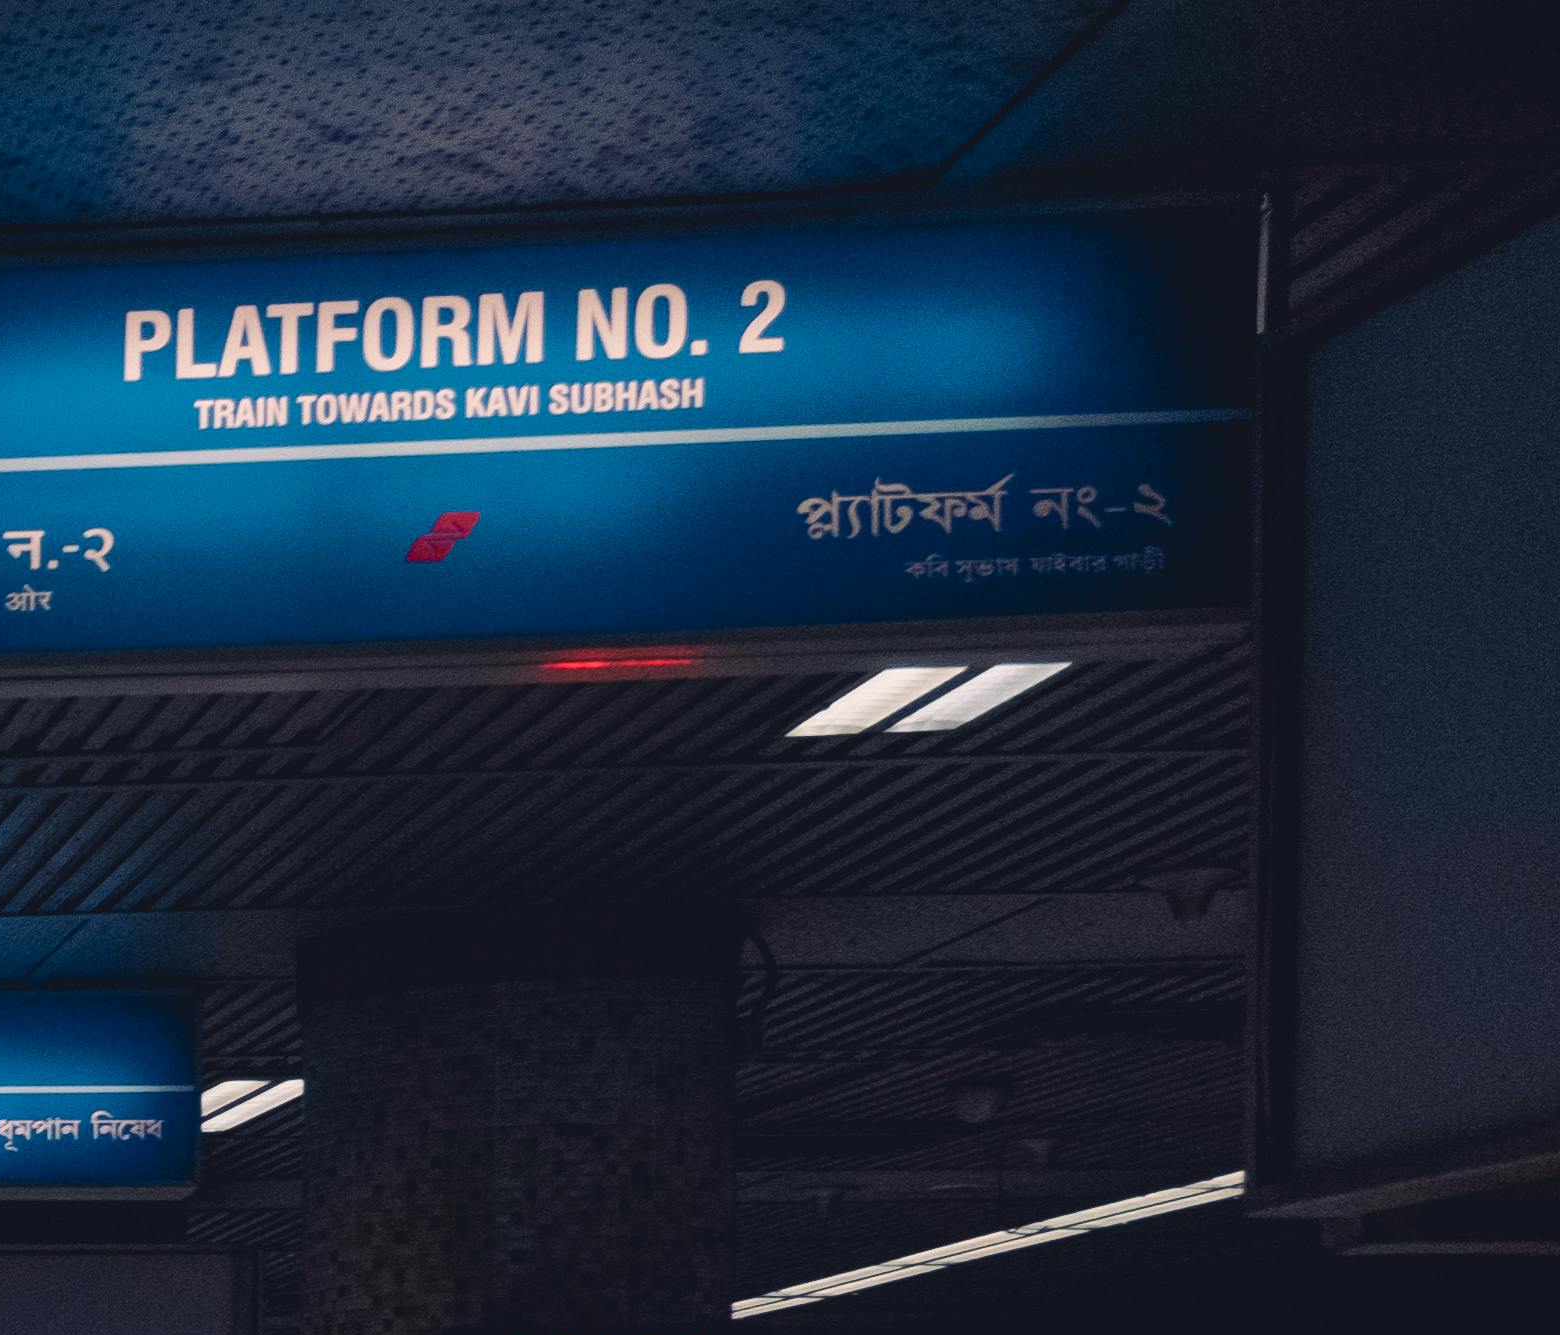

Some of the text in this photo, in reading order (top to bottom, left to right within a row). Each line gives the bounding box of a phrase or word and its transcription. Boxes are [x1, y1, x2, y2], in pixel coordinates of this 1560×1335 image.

[124, 280, 785, 382] PLATFORM NO. 2
[194, 378, 704, 429] TRAIN TOWARDS KAVI SUBHASH
[6, 585, 52, 610] ओर
